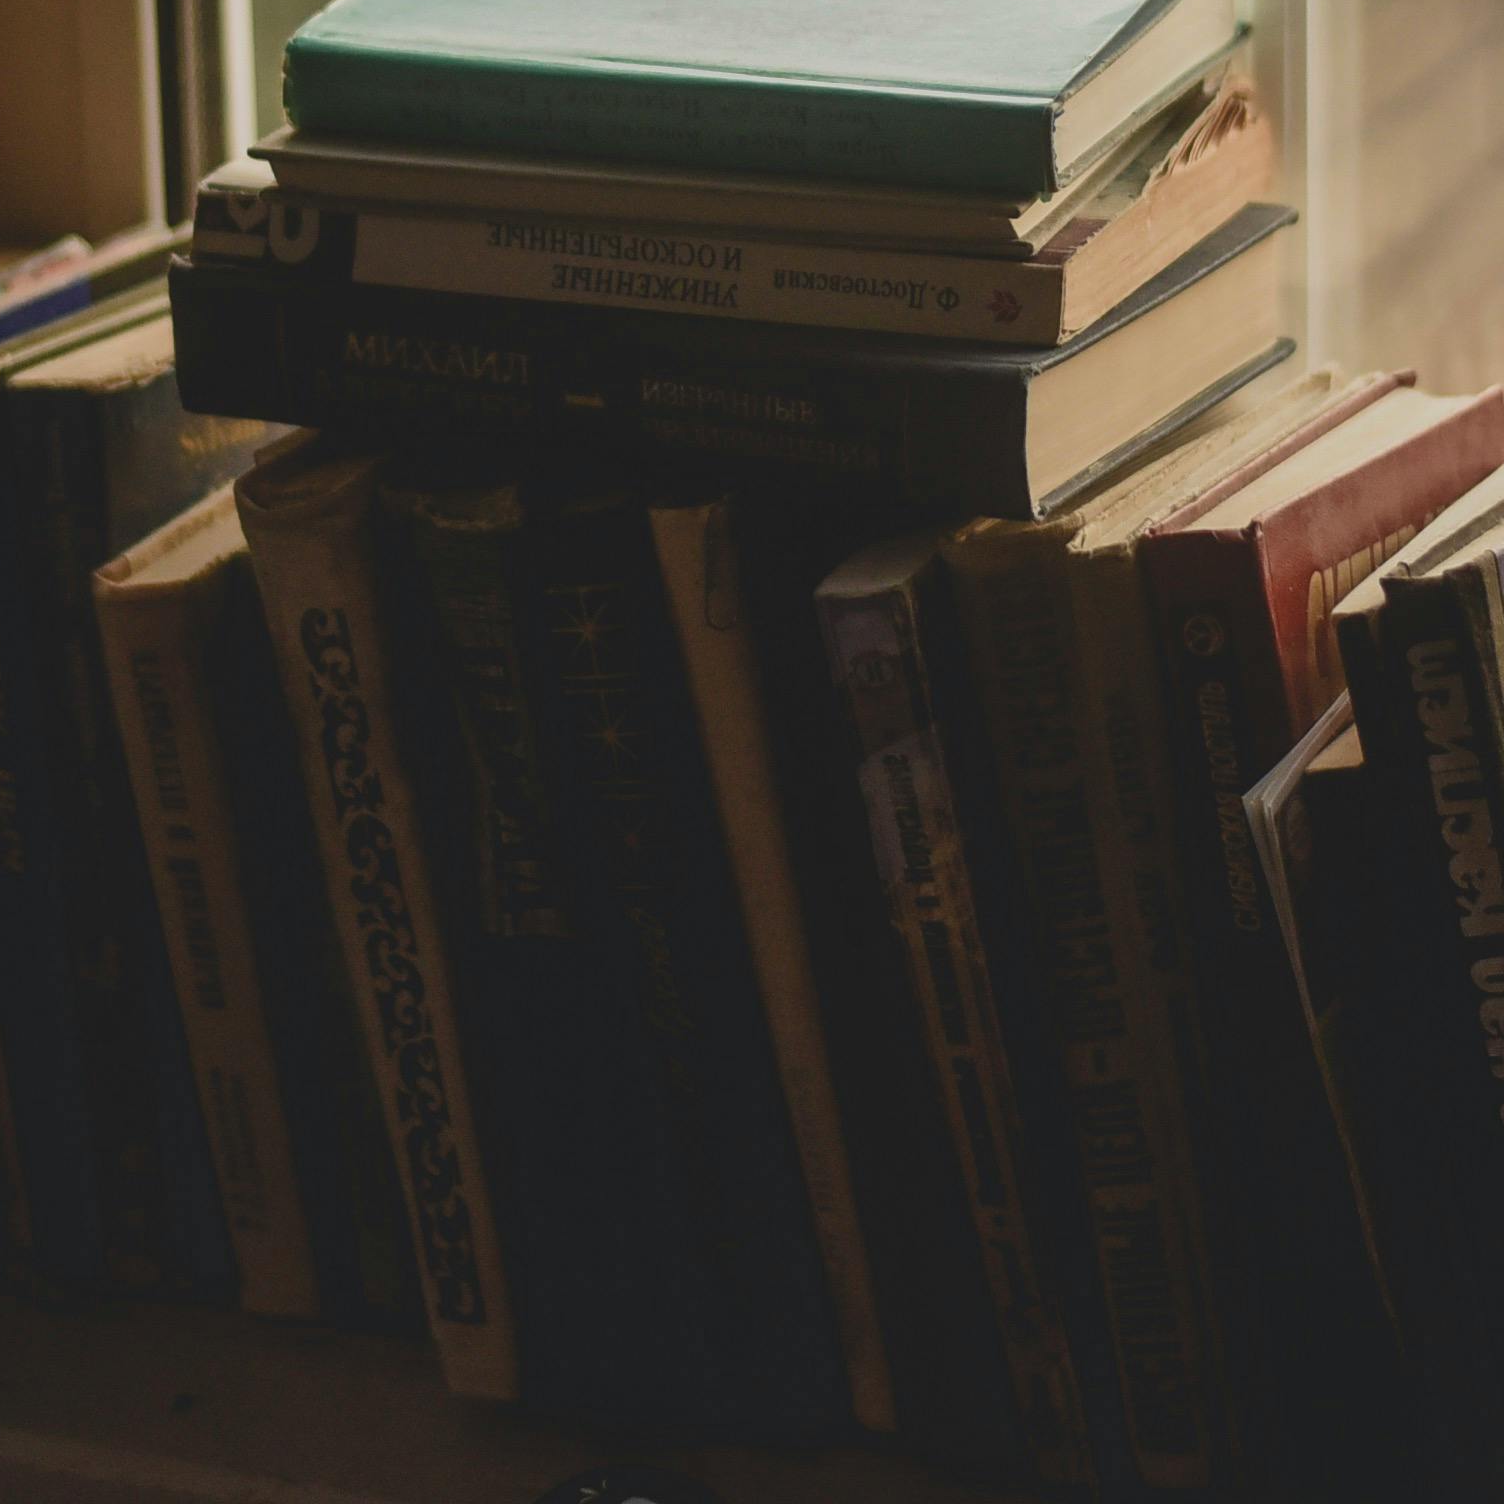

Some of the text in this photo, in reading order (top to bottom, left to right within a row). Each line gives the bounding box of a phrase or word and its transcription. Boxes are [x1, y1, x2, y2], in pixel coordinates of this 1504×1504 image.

[486, 220, 742, 272] И ОСКОРБЛЕННЫЕ
[552, 264, 739, 309] УНИЖЕННЫЕ
[344, 330, 530, 386] МИХАИЛ
[1198, 681, 1240, 784] ПОСТУПЬ
